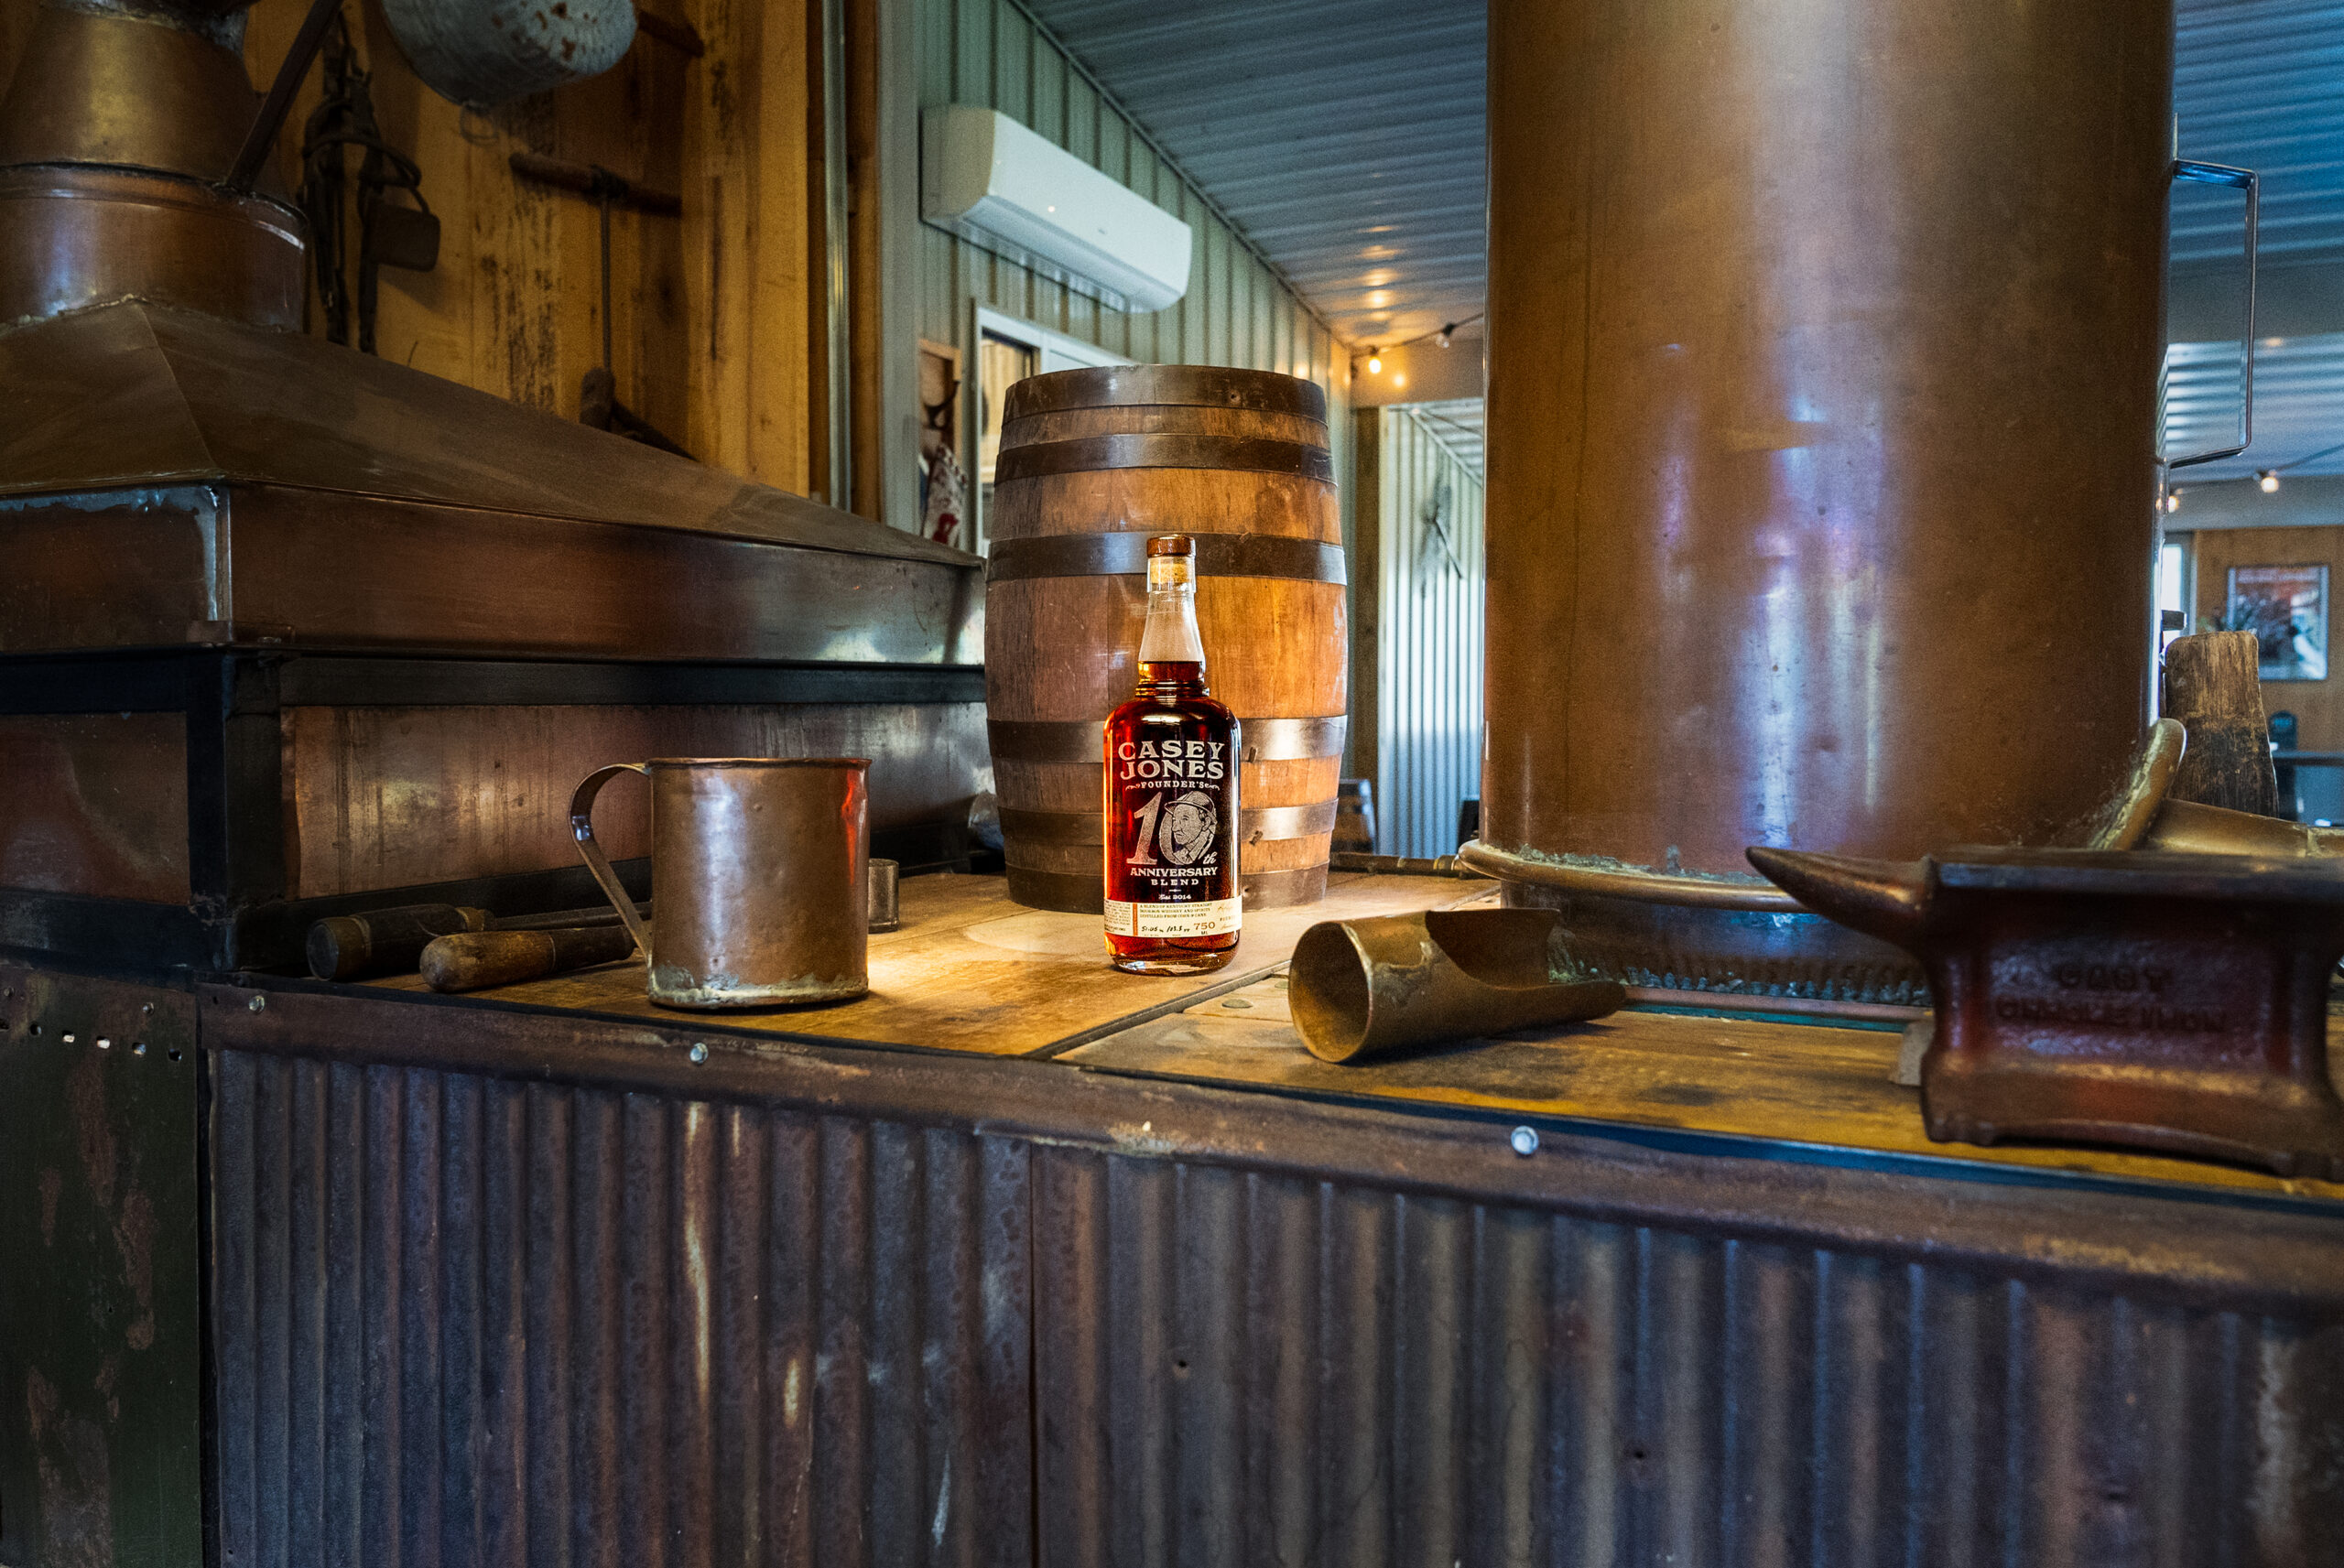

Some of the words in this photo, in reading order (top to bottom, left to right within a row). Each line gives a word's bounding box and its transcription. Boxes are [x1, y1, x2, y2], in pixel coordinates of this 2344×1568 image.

[1118, 740, 1225, 761] CASEY
[1120, 759, 1224, 780] JONES
[1130, 867, 1218, 877] ANNIVERSARY
[1193, 922, 1215, 930] 750
